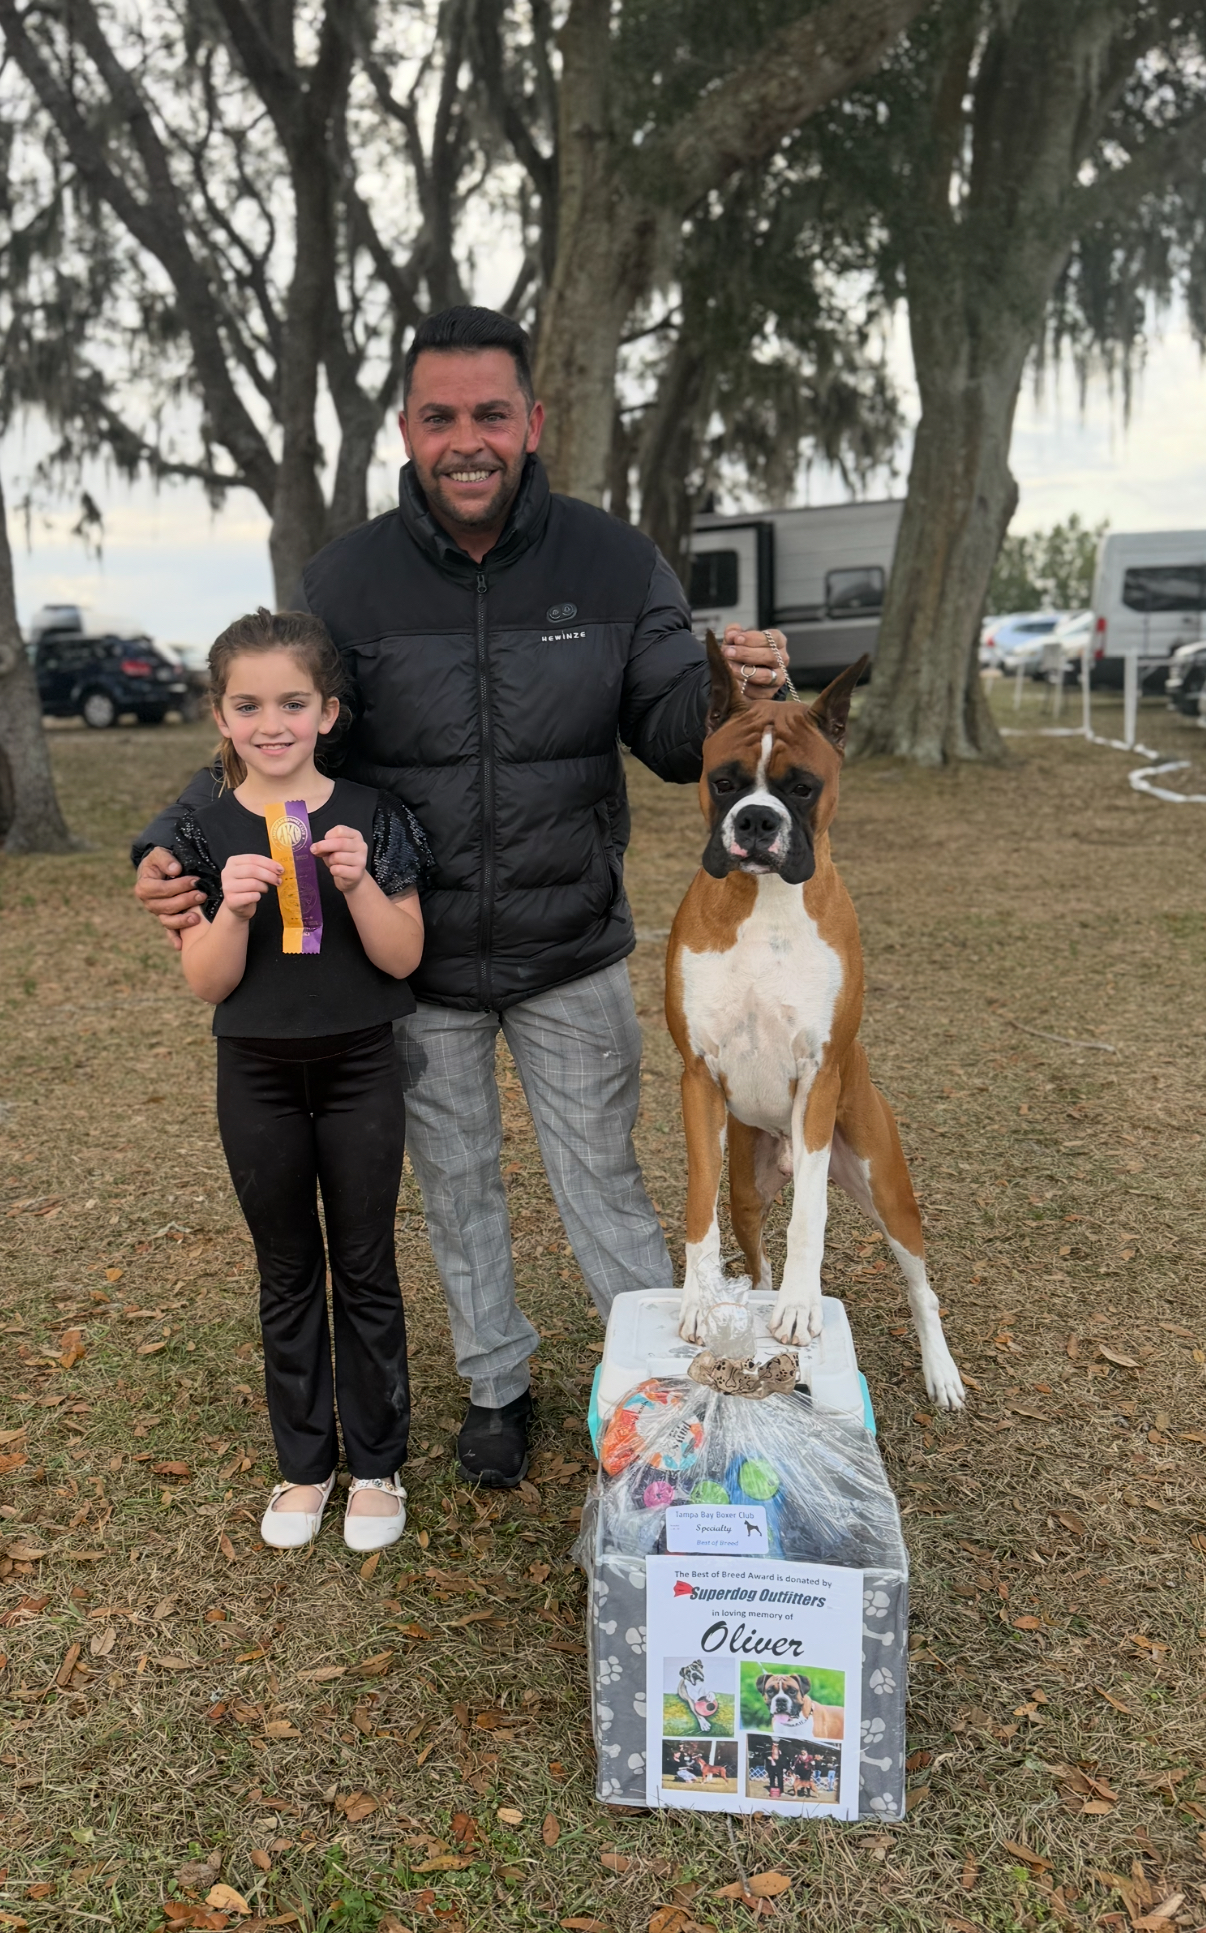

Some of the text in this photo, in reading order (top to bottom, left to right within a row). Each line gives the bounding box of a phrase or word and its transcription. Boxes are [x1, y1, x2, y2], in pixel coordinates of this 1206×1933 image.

[277, 824, 301, 845] AKC
[675, 1511, 755, 1520] Tampa Bay Boxer Club
[695, 1523, 732, 1534] Specialty
[674, 1570, 690, 1578] The
[711, 1570, 720, 1578] of
[722, 1571, 746, 1579] Breed
[748, 1572, 775, 1581] Award
[776, 1574, 784, 1582] is
[785, 1575, 820, 1586] donated
[822, 1579, 833, 1589] by
[689, 1586, 827, 1608] Superdog Outfitters
[711, 1609, 794, 1621] in loving memory of
[700, 1620, 805, 1657] Oliver
